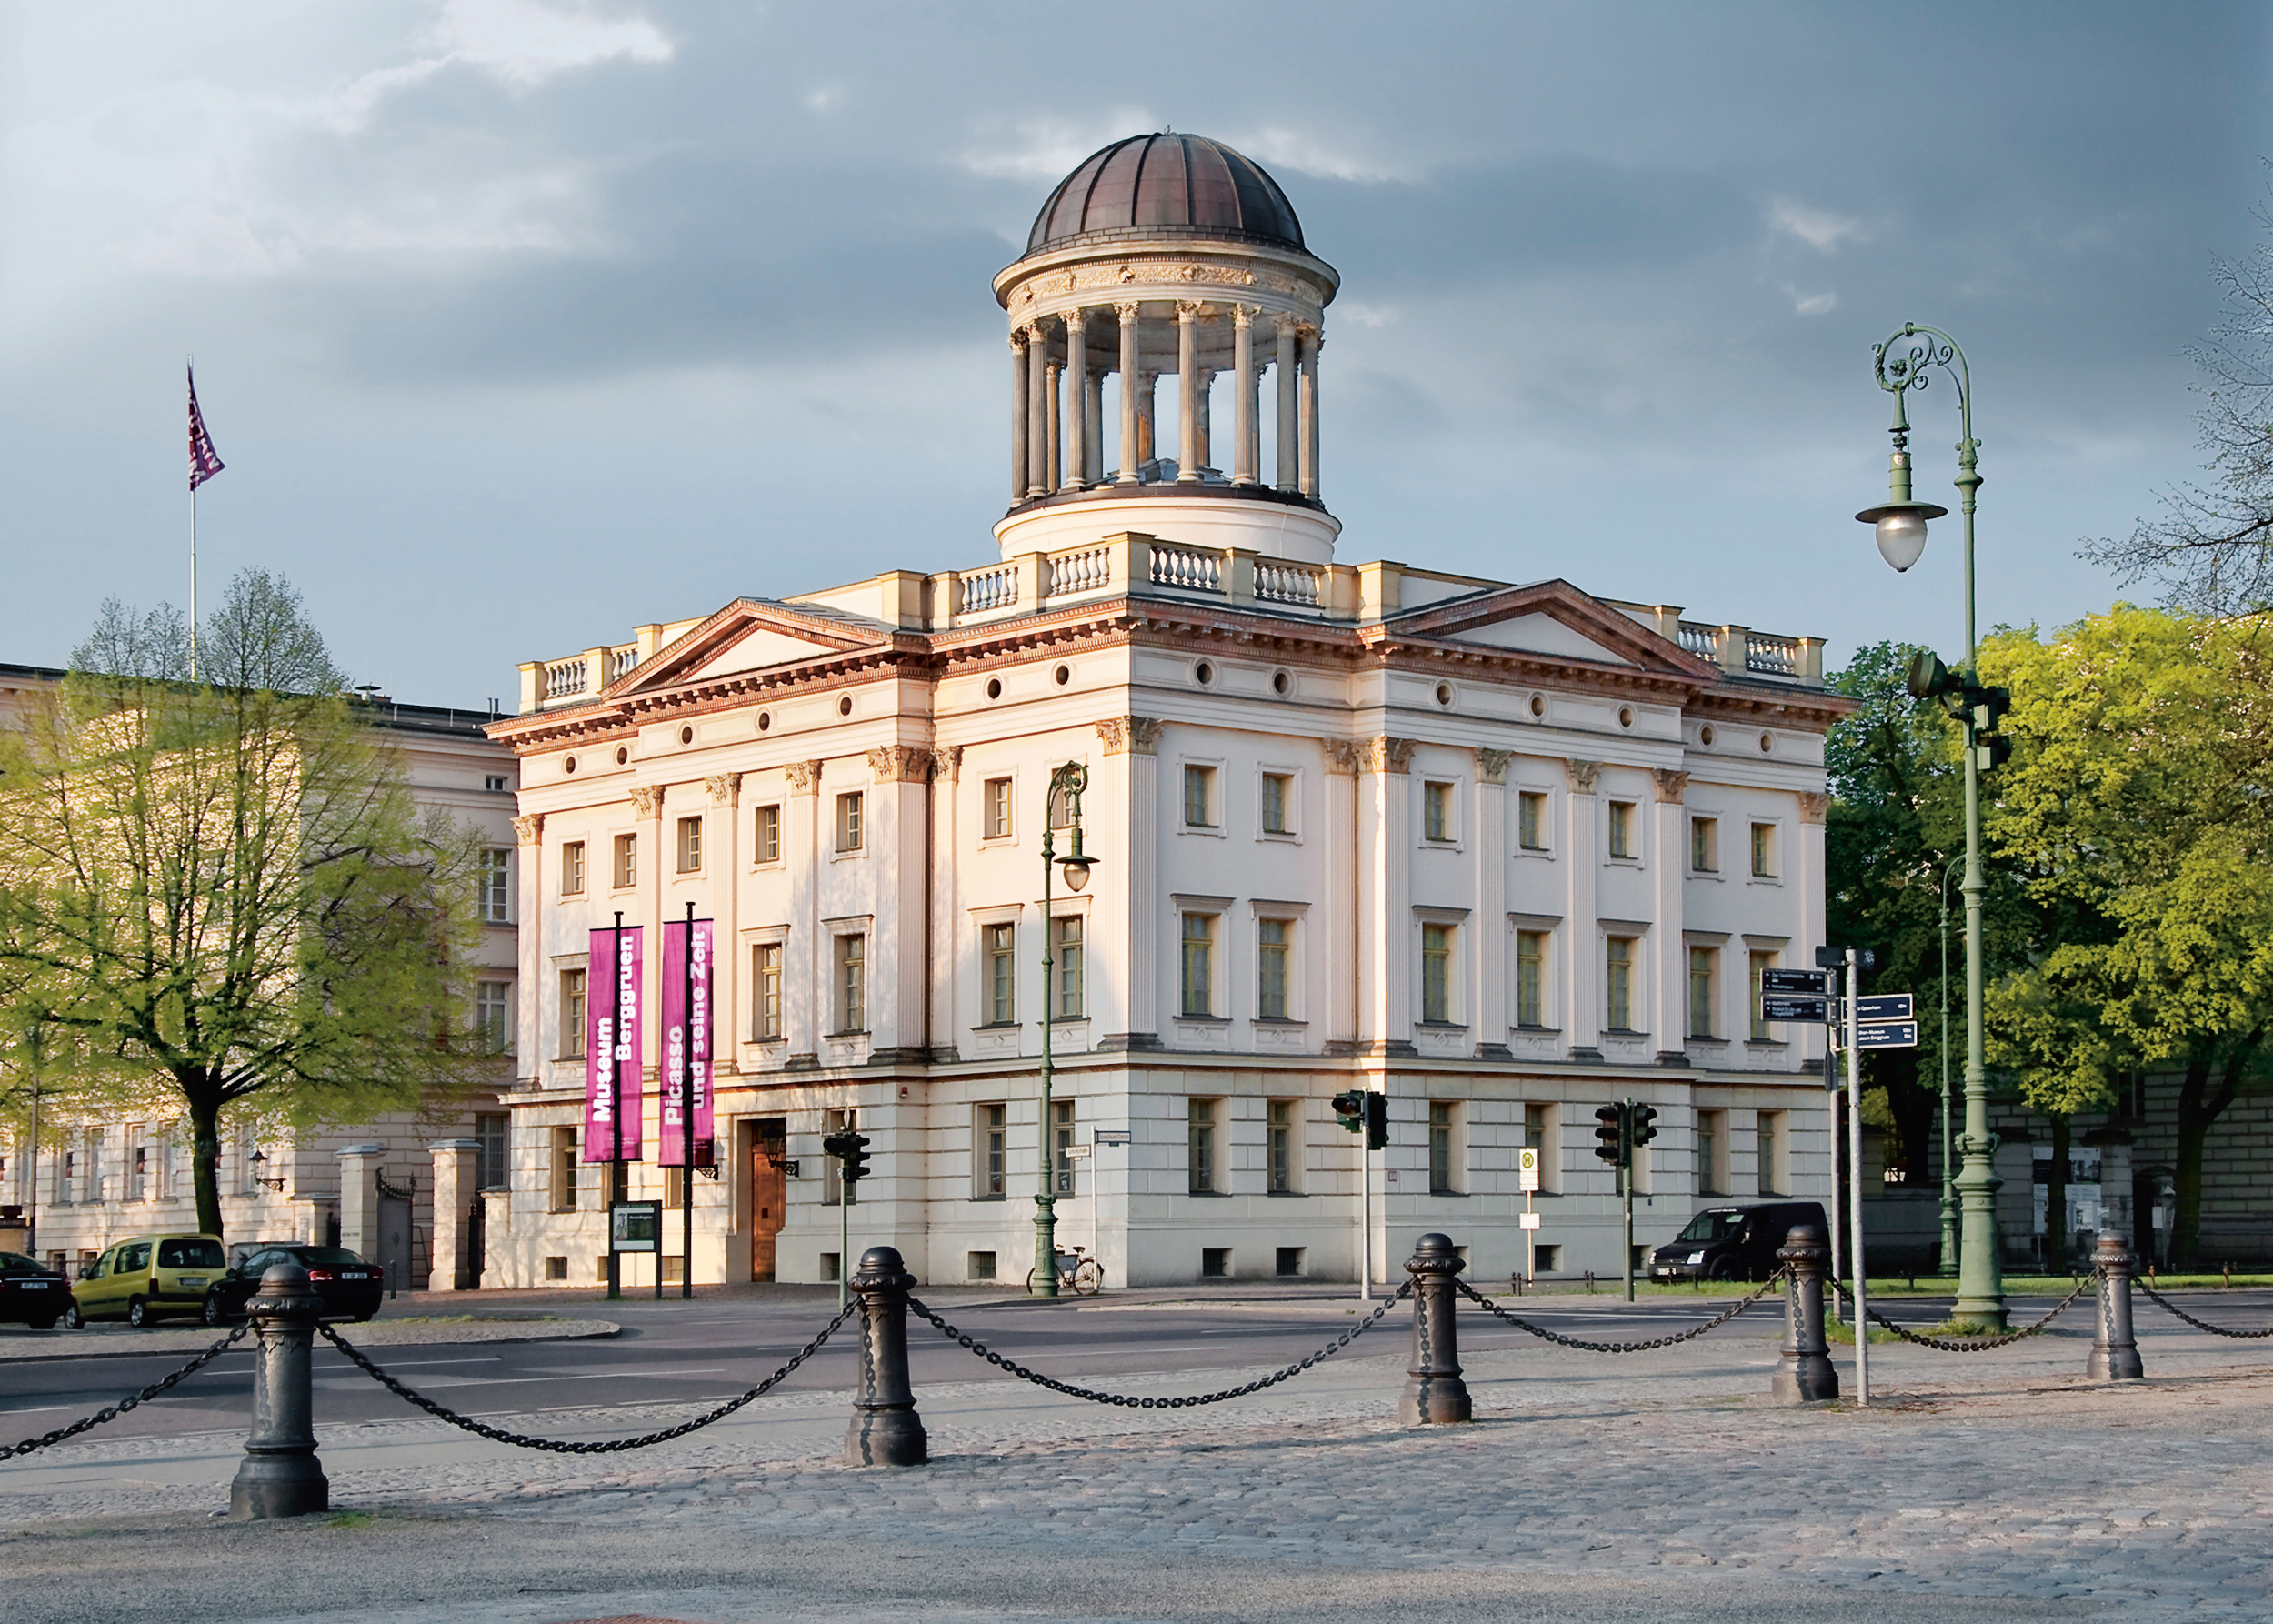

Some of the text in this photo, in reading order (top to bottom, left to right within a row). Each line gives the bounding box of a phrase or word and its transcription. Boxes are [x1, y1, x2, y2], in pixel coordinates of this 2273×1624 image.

[616, 936, 636, 1061] Berggruen
[689, 931, 706, 1109] und seine Zeit
[593, 1018, 613, 1122] Museum
[665, 1025, 684, 1125] Picasso
